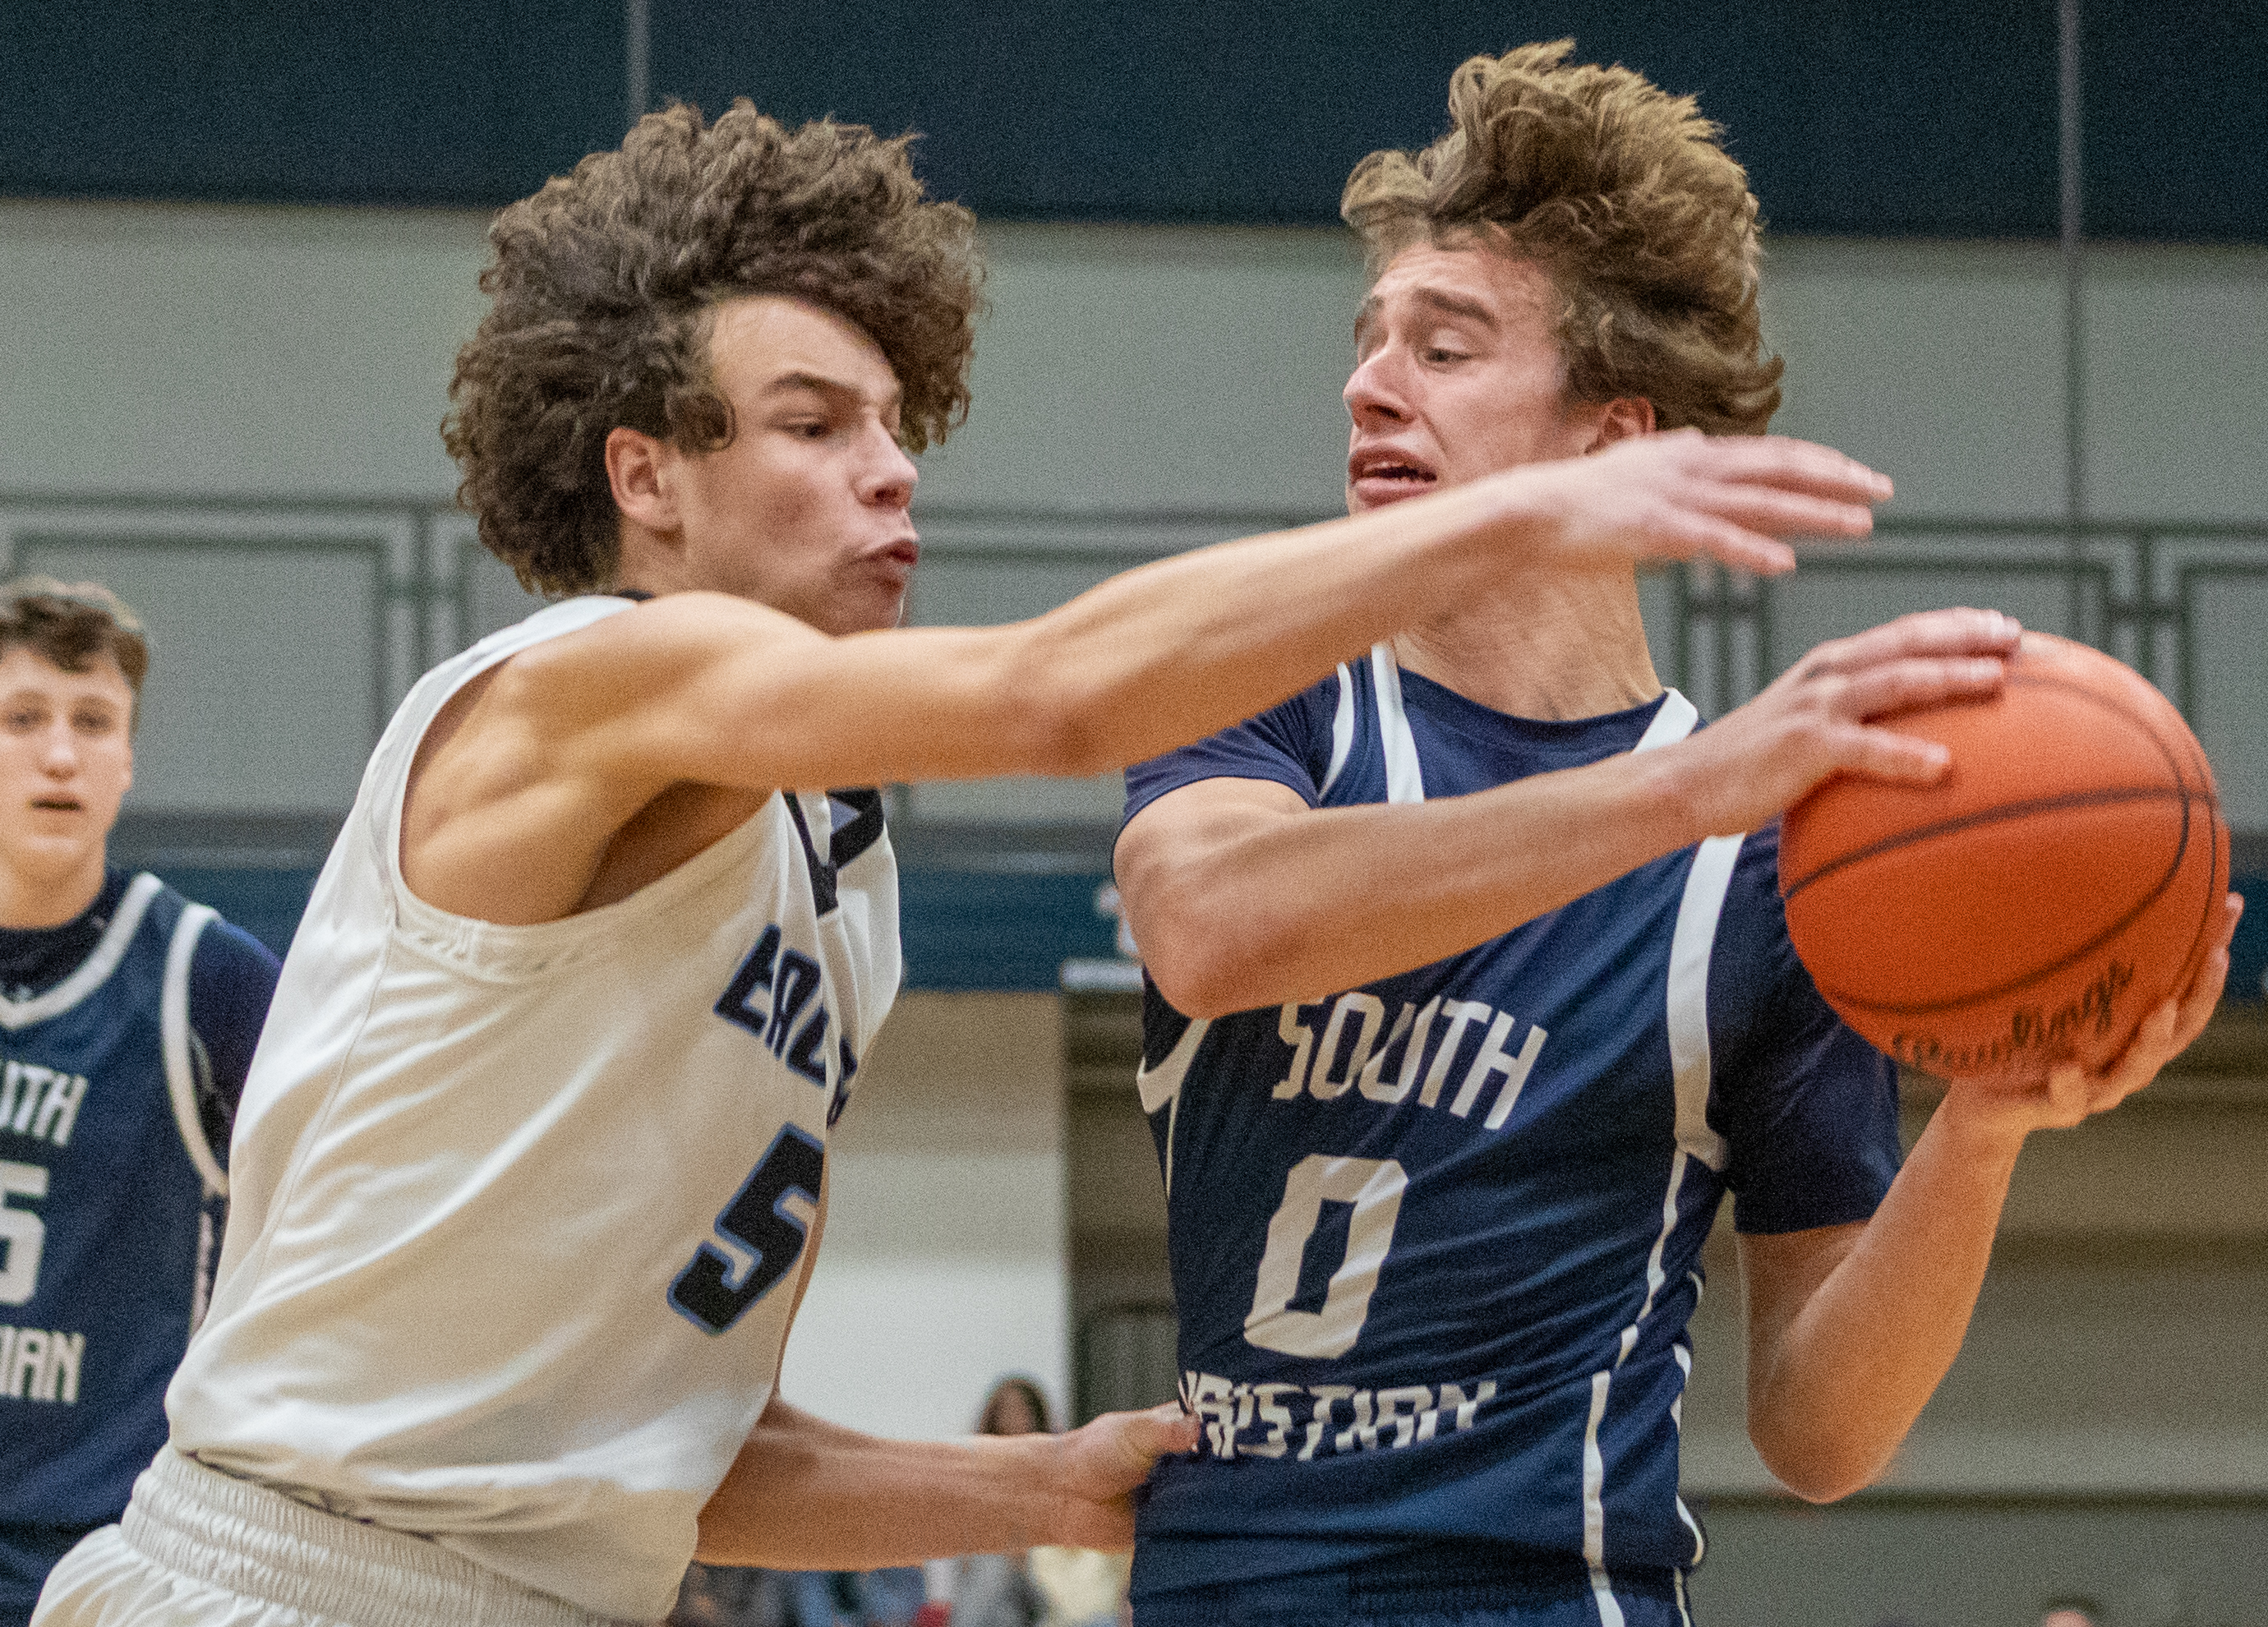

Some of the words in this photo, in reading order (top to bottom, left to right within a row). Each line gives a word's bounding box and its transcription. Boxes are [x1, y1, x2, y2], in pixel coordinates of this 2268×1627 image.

[1271, 991, 1550, 1132] SOUTH
[666, 1121, 824, 1335] 5
[1243, 1153, 1409, 1358] 0
